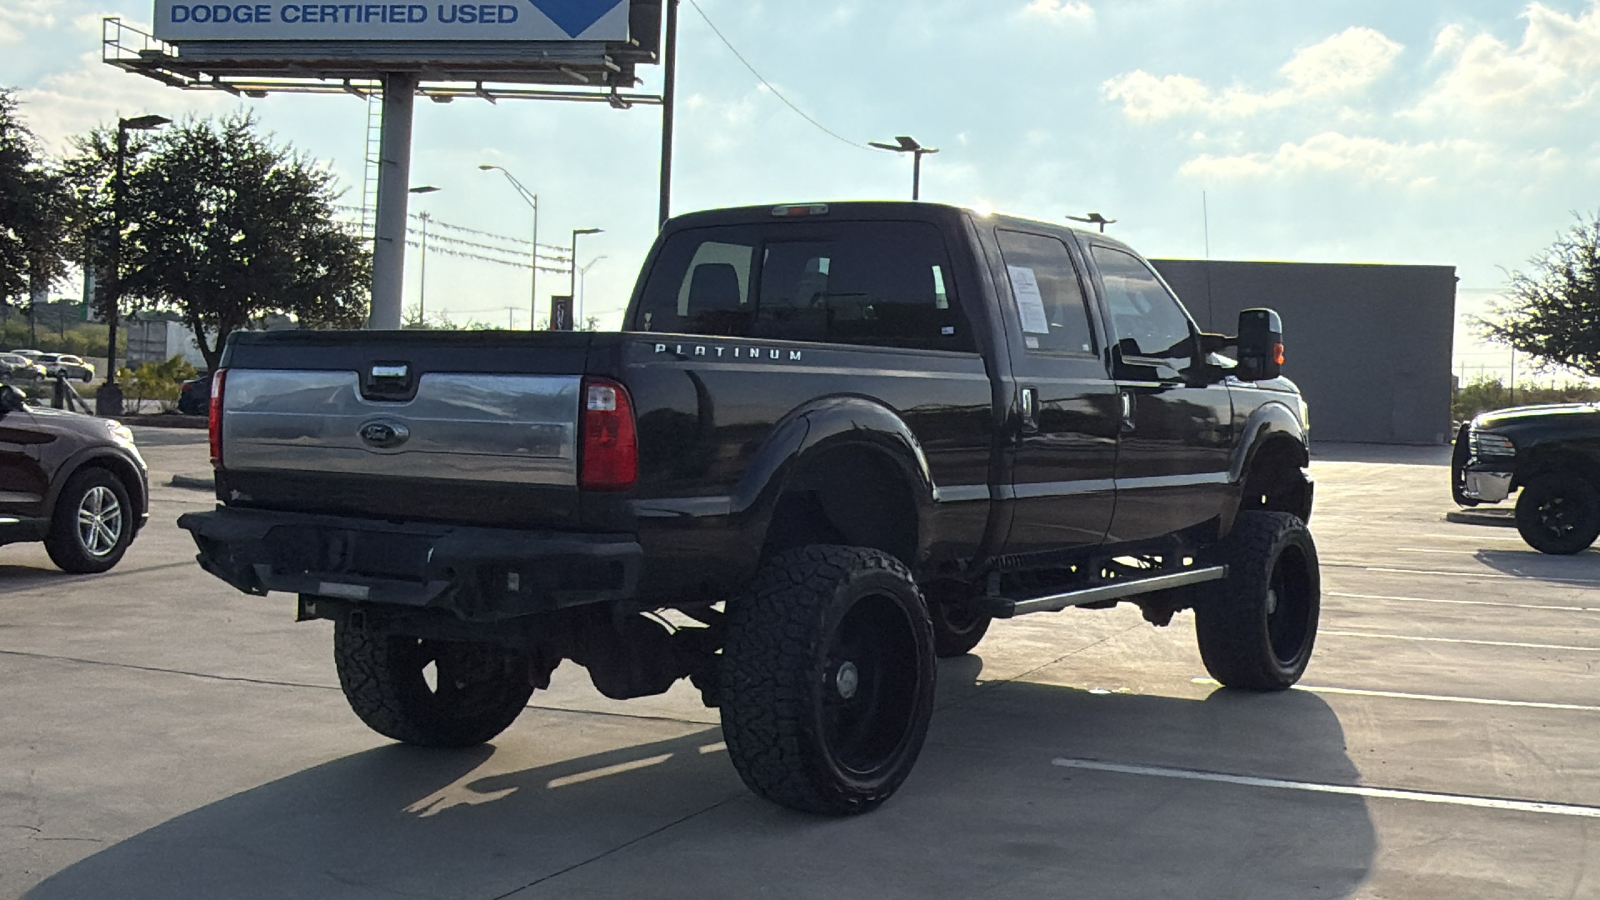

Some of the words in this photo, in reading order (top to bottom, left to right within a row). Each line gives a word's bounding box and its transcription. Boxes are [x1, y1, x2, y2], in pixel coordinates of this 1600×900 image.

[171, 4, 271, 24] DODGE
[280, 4, 428, 24] CERTIFIED
[437, 4, 519, 24] USED
[654, 343, 802, 361] PLATINUM
